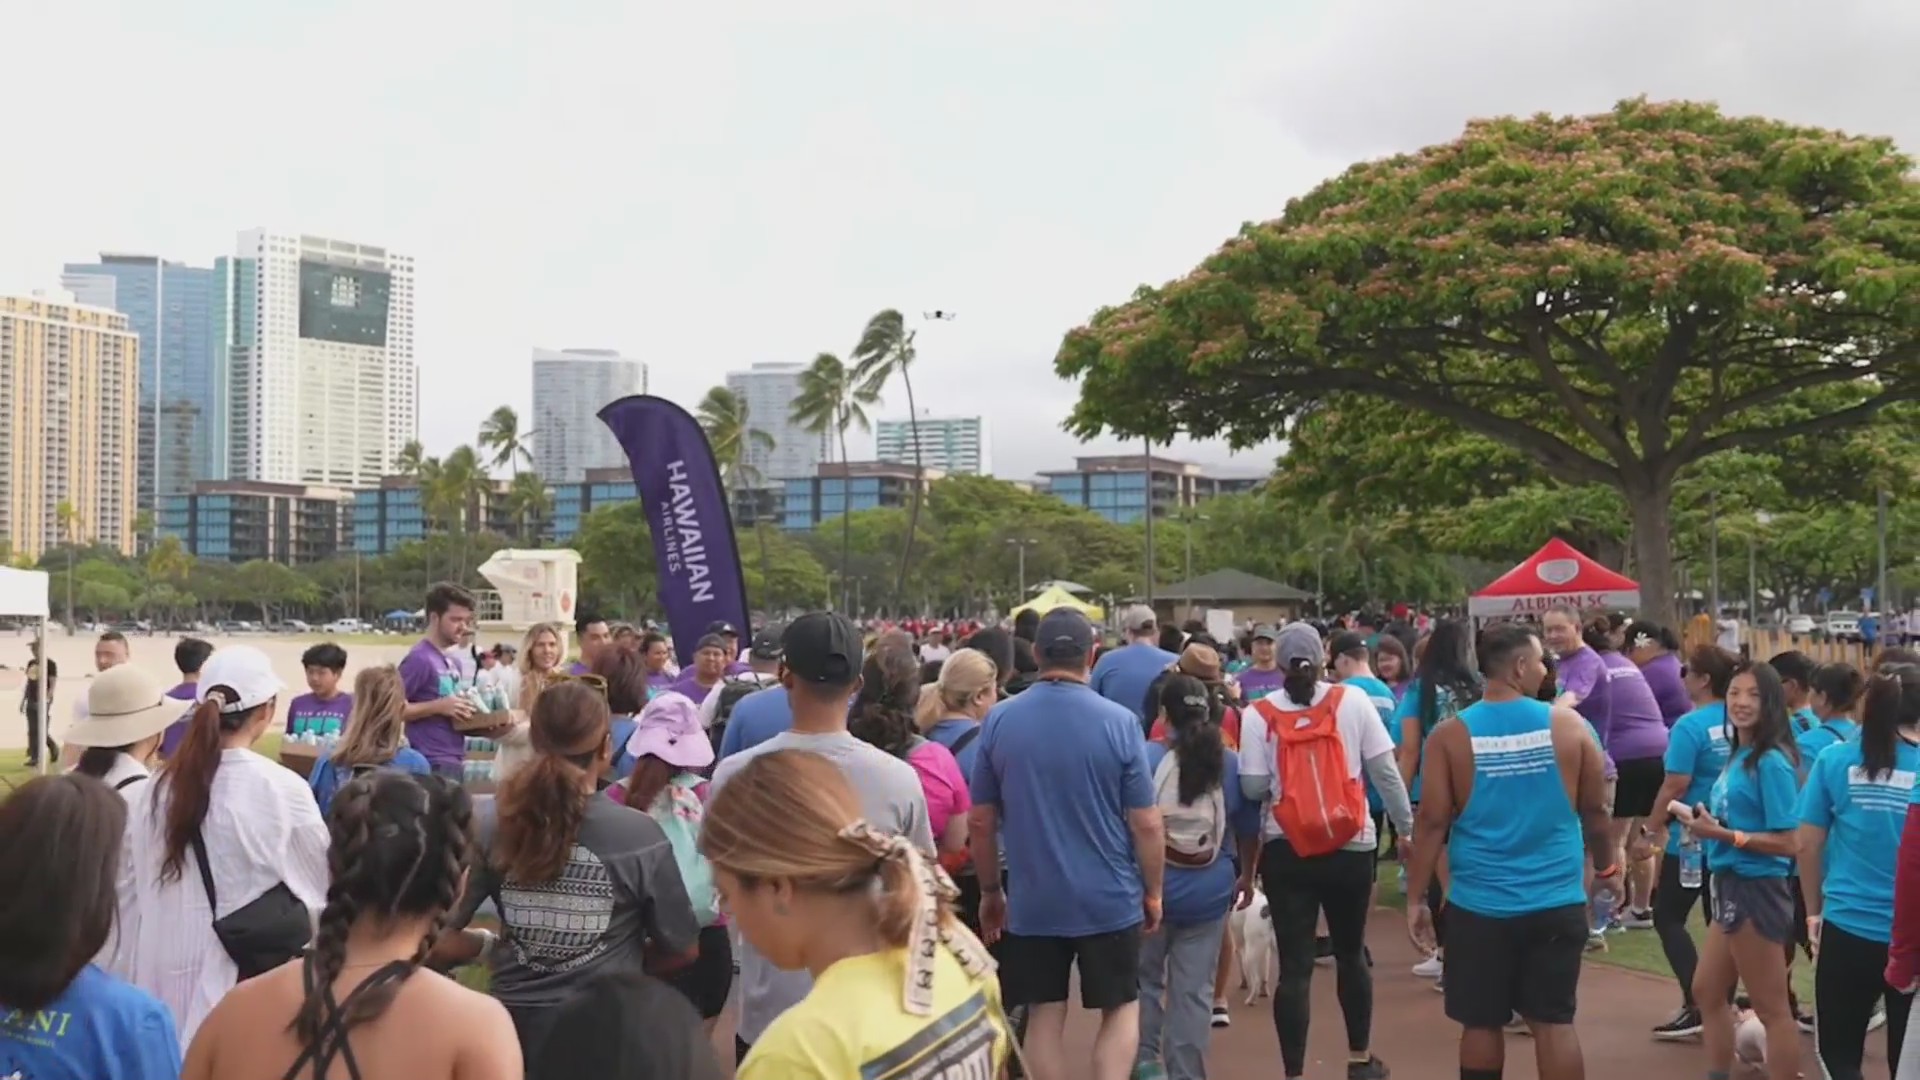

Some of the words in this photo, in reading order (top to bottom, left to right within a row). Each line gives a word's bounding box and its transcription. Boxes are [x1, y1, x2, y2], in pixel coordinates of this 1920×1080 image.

[660, 501, 682, 574] AIRLINES
[666, 460, 715, 603] HAWAIIAN
[1511, 594, 1582, 612] ALBION
[1588, 593, 1609, 609] SC
